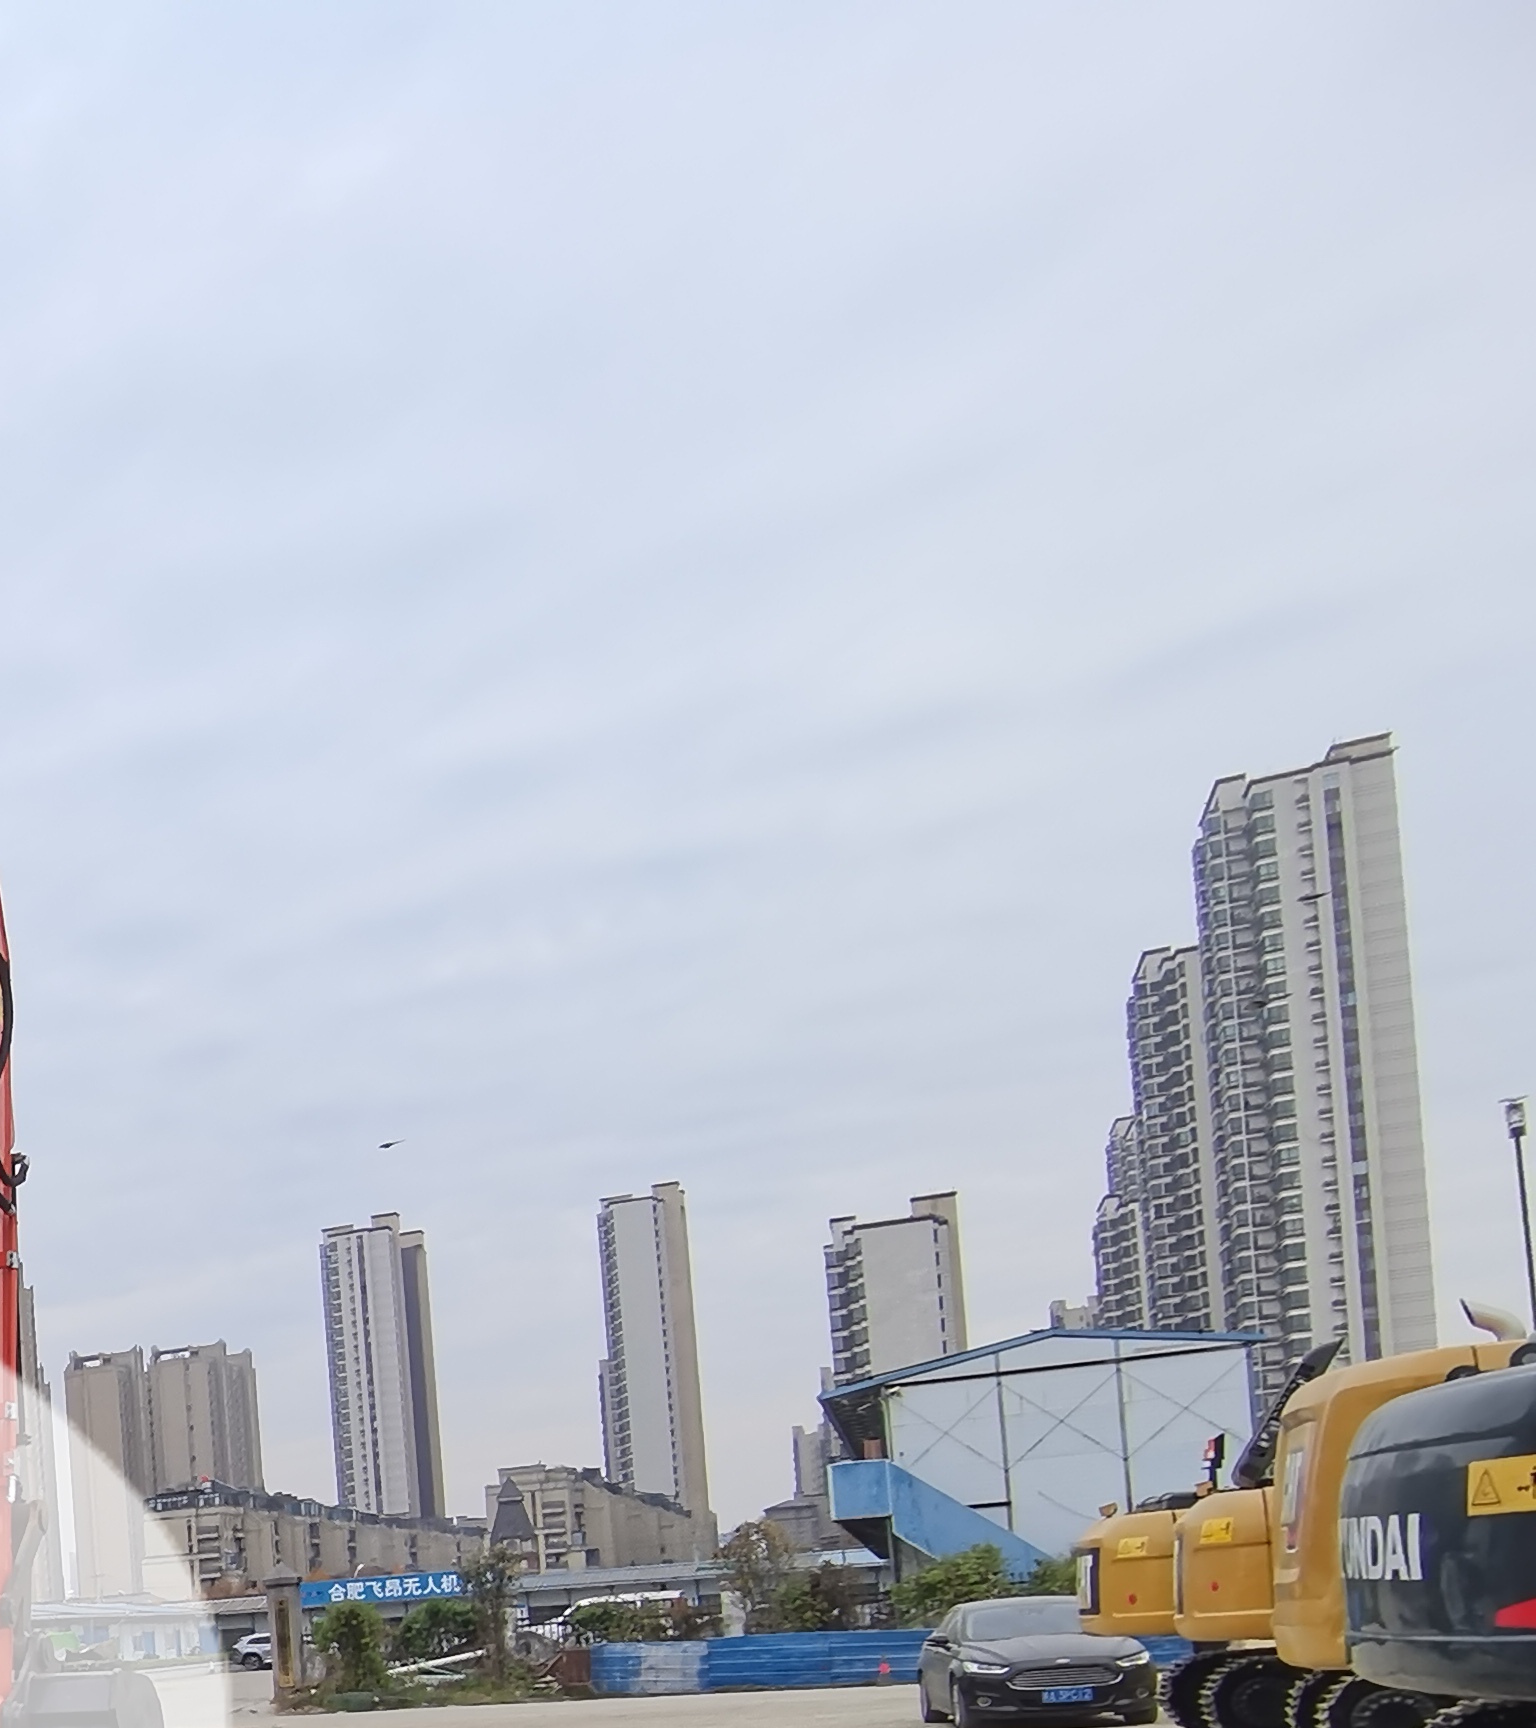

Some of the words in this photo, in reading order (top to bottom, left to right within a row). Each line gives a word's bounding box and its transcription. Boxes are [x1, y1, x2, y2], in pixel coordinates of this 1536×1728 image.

[328, 1574, 462, 1602] 合肥飞昂无人机
